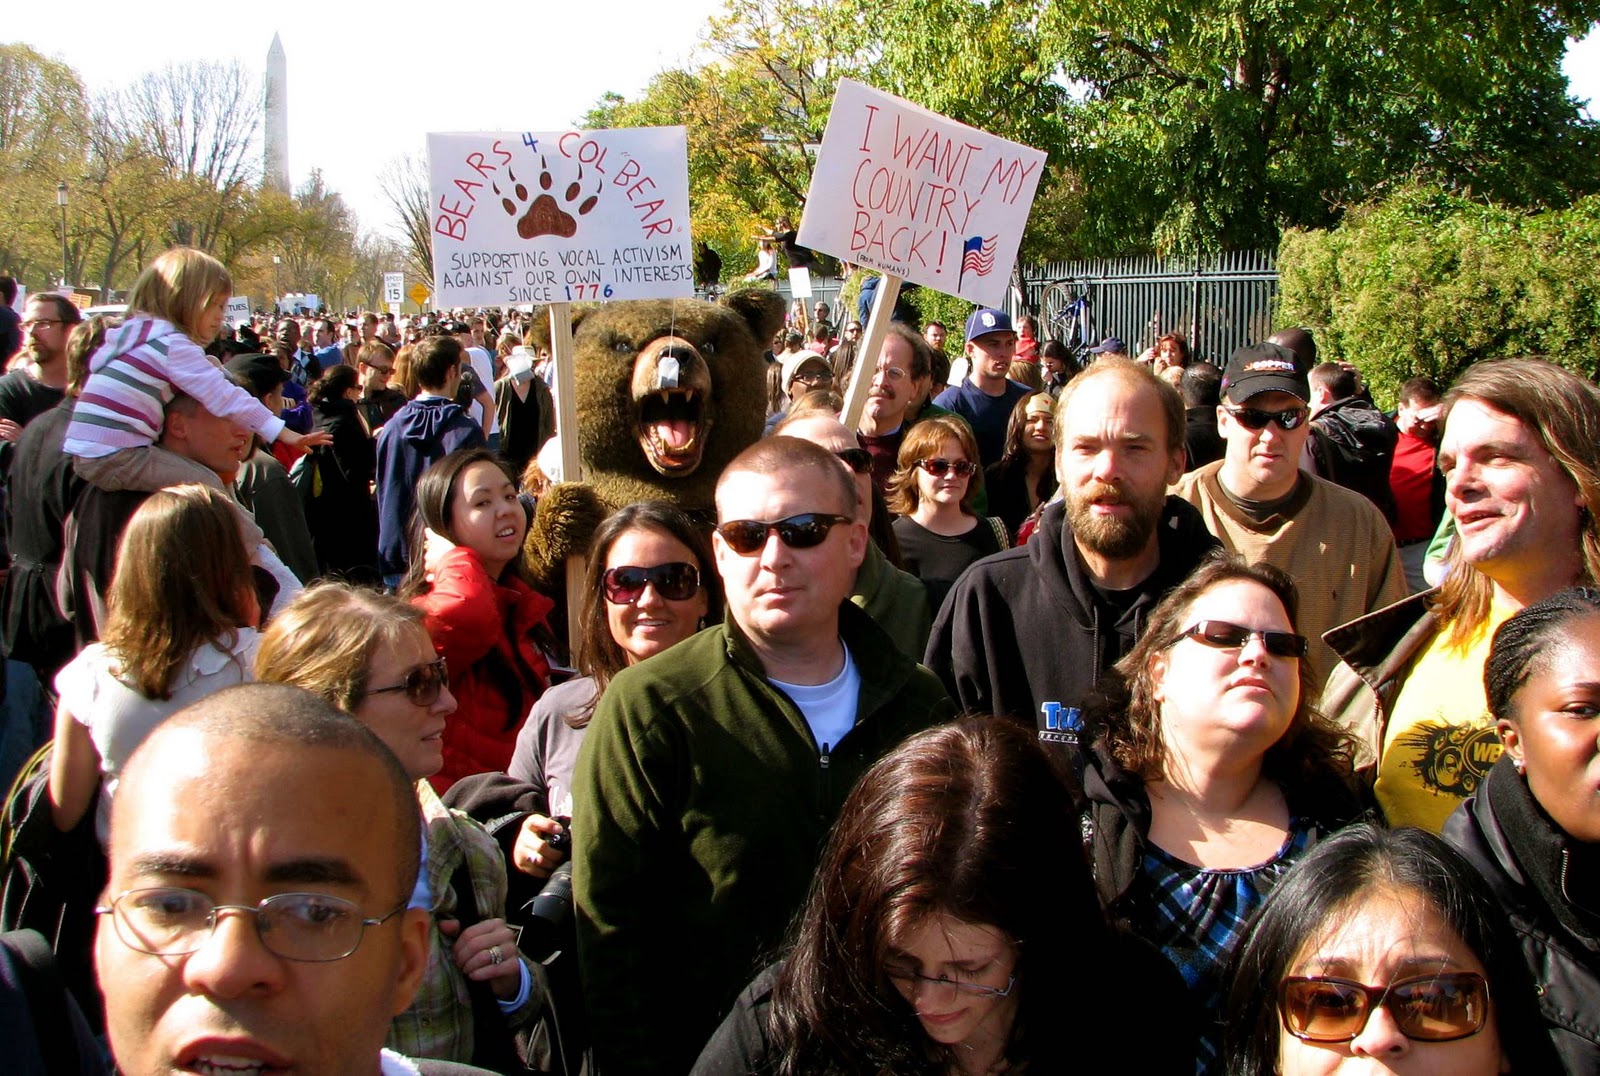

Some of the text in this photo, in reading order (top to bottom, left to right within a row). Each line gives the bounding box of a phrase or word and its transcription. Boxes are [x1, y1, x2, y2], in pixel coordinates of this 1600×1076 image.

[859, 104, 1037, 204] I WANT MY
[434, 140, 512, 241] BEARS
[521, 131, 538, 153] 4
[853, 158, 980, 235] COUNTRY
[451, 244, 683, 271] SUPPORTING VOCAL ACTIVISM
[850, 211, 947, 274] BACK!
[388, 289, 400, 300] 15
[443, 263, 693, 290] AGAINST OUR OWN INTERESTS
[509, 284, 613, 302] SINCE 1776
